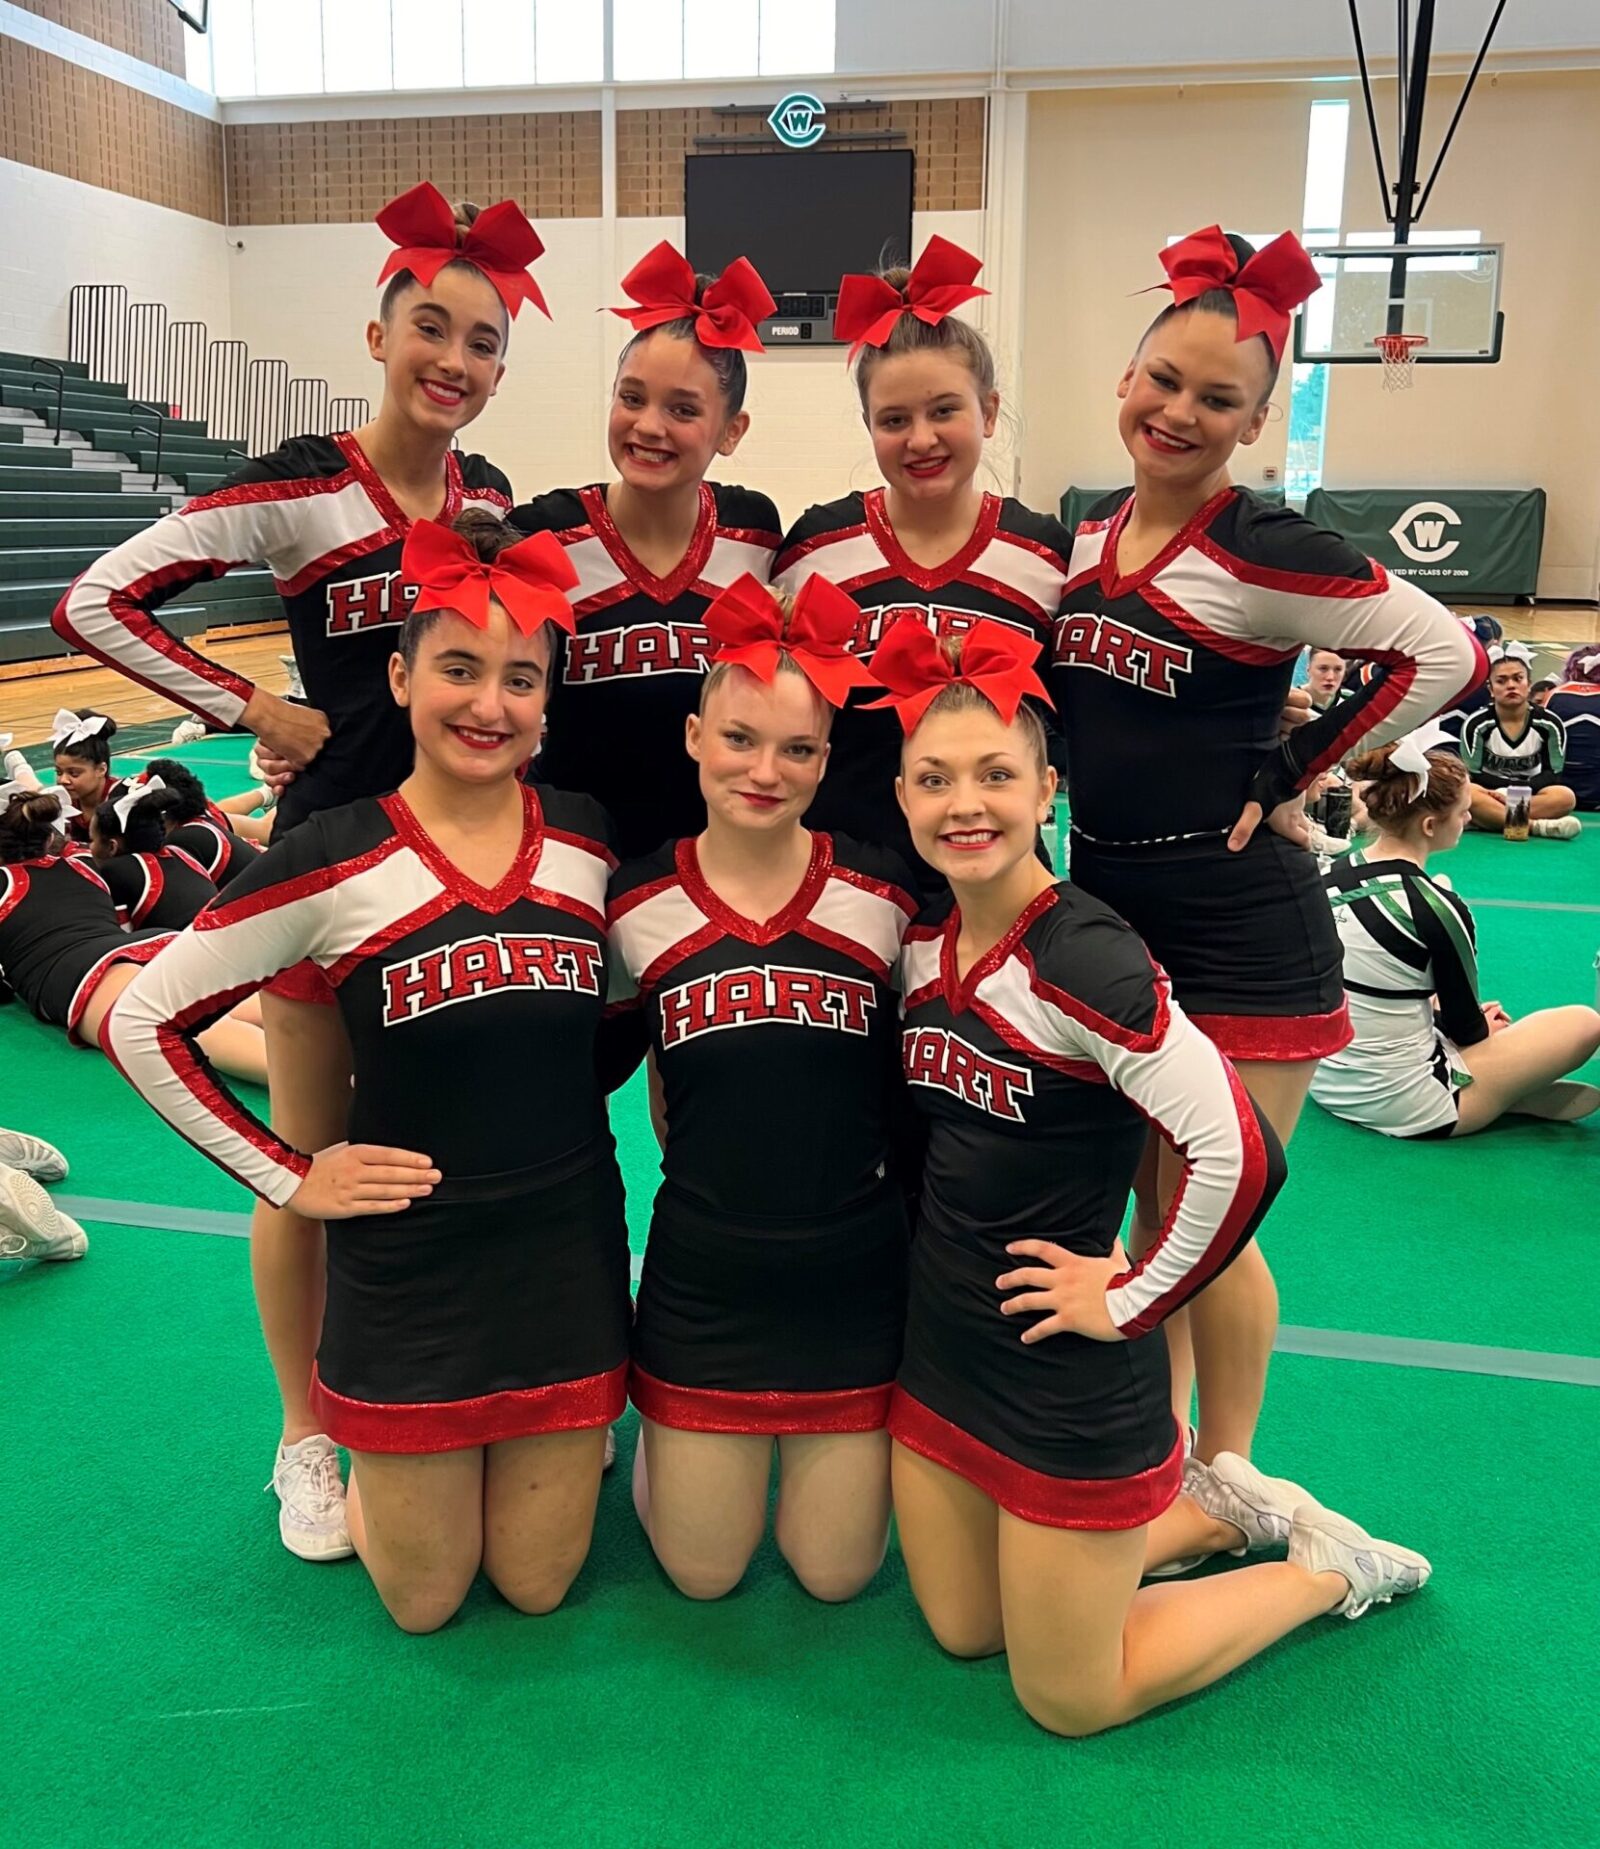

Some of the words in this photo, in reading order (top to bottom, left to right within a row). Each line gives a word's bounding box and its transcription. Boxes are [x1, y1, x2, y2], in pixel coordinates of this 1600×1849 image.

[771, 326, 799, 336] PERIOD
[326, 570, 420, 637] HA
[1388, 568, 1407, 576] ATED
[562, 621, 726, 685] HAR
[383, 932, 604, 1027] HART
[659, 964, 877, 1051] HART
